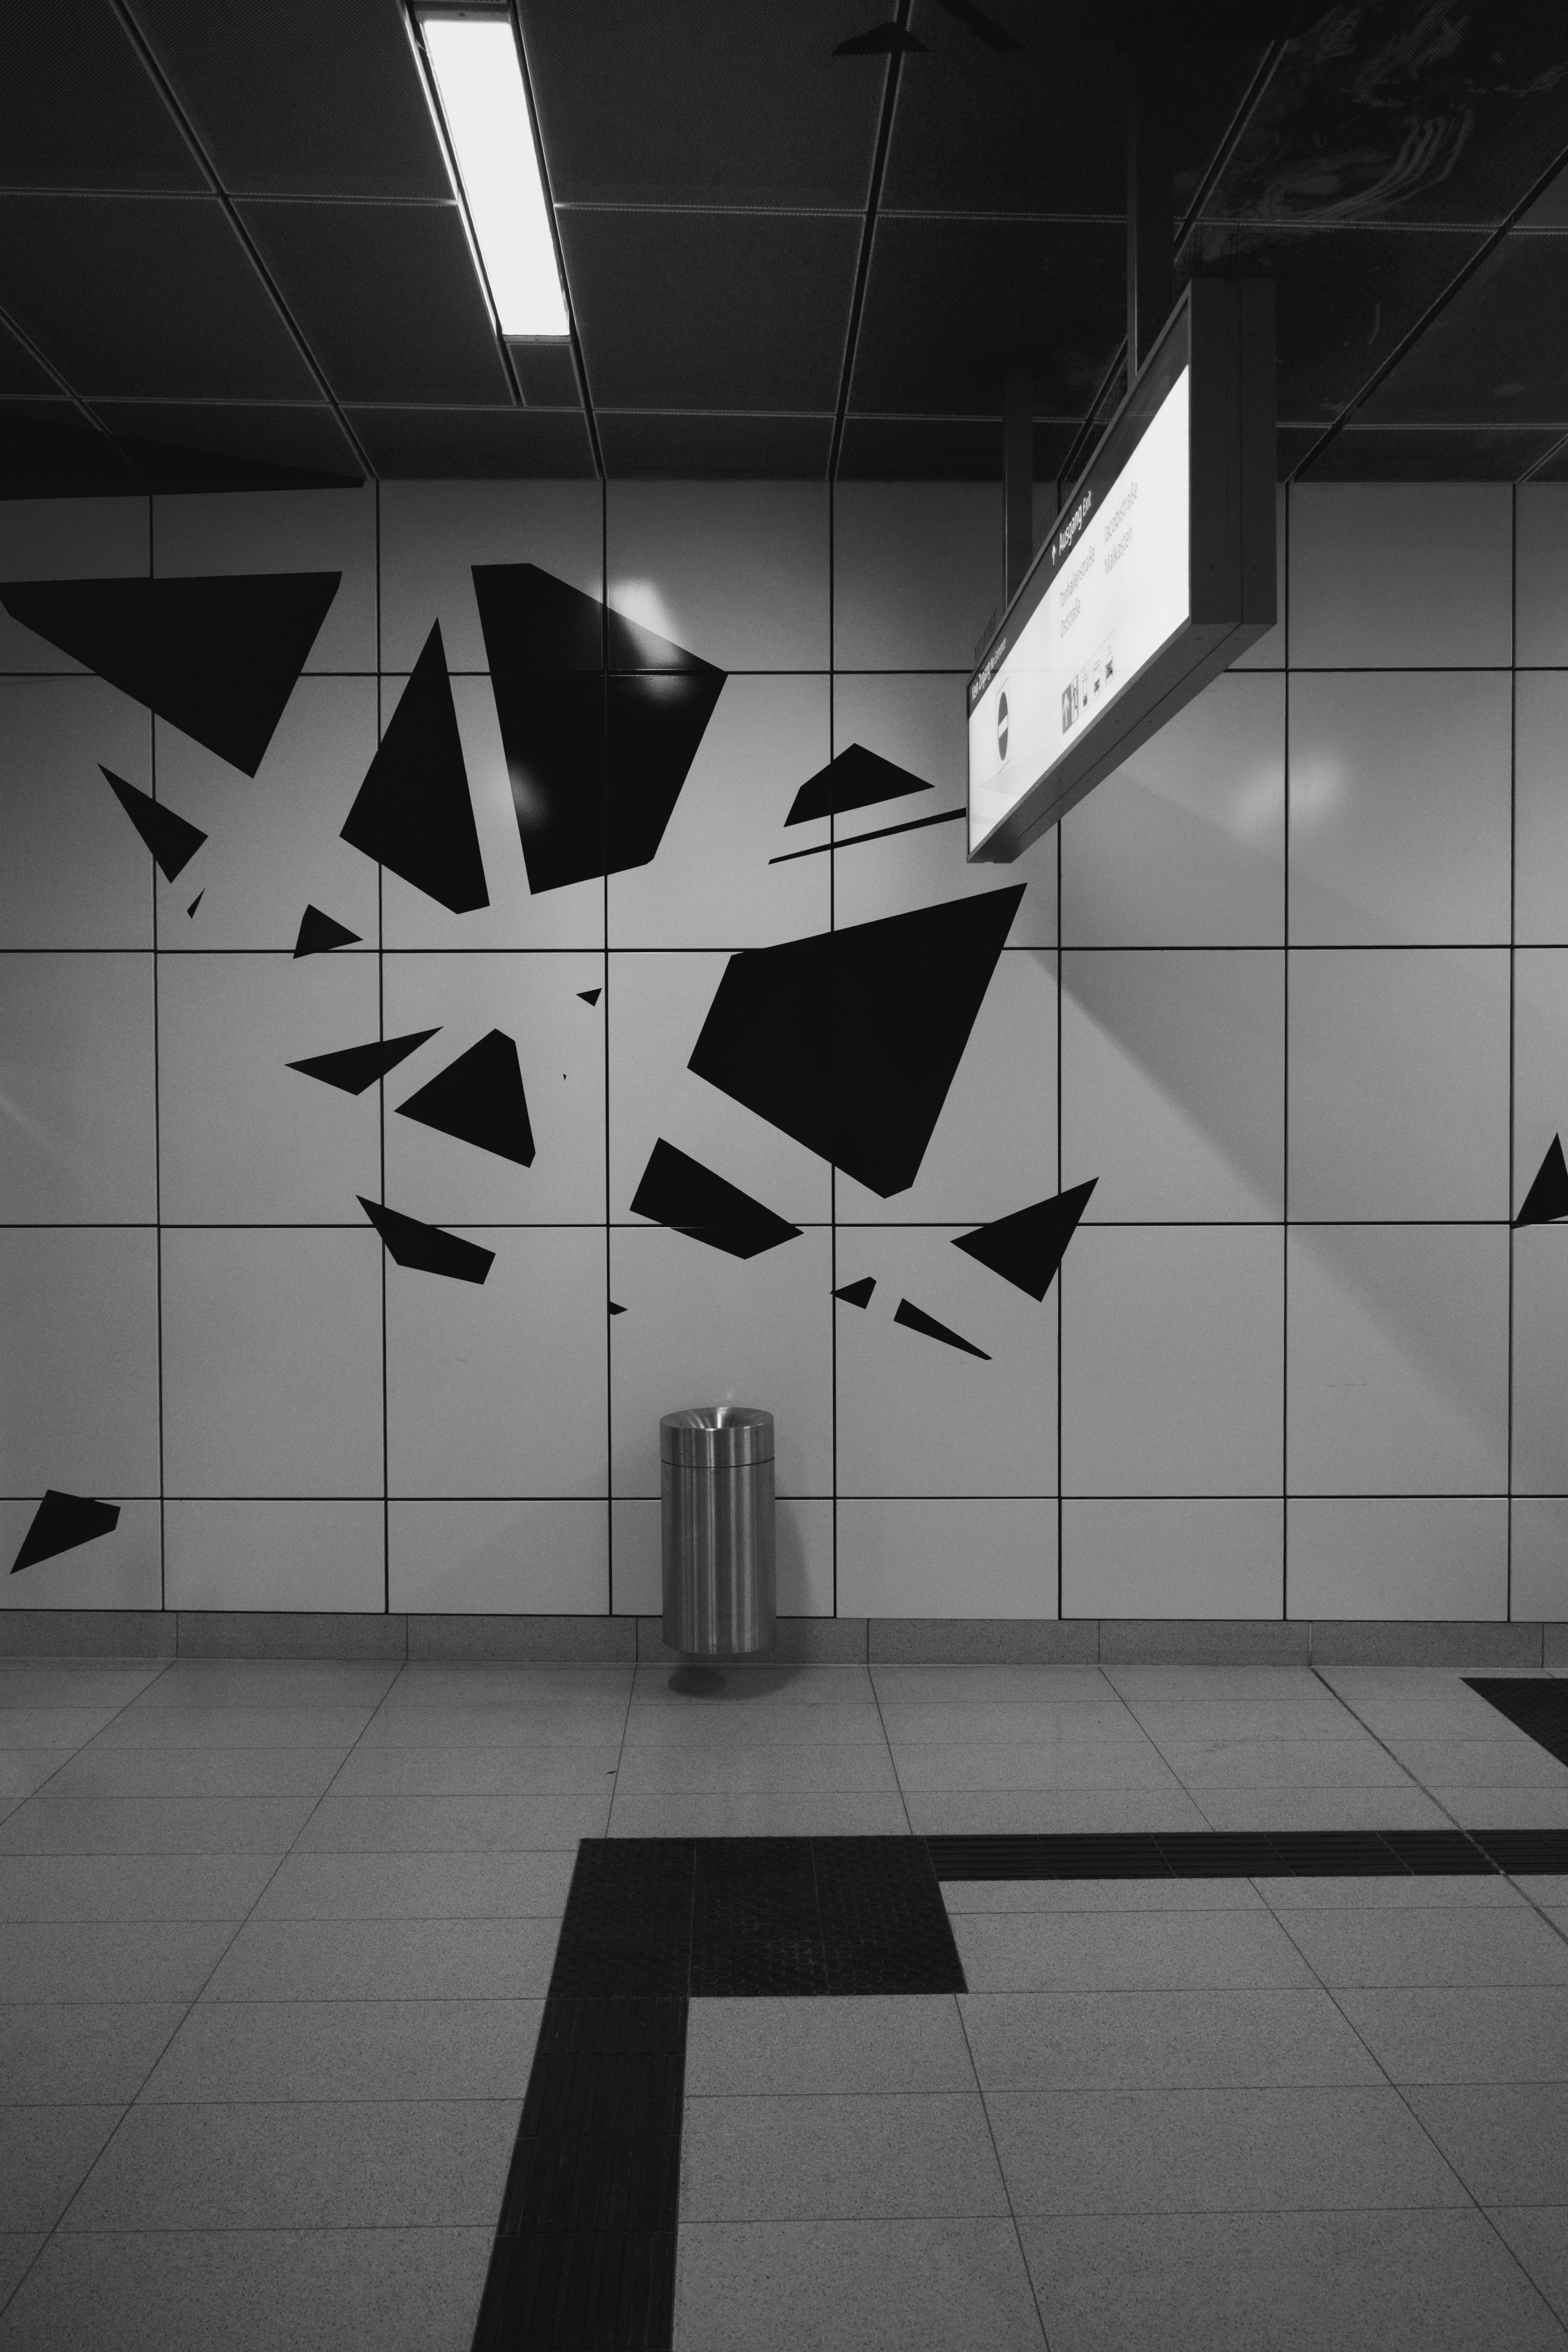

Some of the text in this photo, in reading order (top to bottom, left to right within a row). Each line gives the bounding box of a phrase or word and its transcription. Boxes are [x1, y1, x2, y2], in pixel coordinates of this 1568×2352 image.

[1059, 490, 1092, 556] Ausgang Exit
[1104, 482, 1138, 546] Jacobistraße
[1060, 546, 1095, 609] Tonhallenstraße
[1105, 526, 1132, 577] Malkasten
[1060, 598, 1081, 638] Oststraße
[979, 662, 990, 690] Zugang
